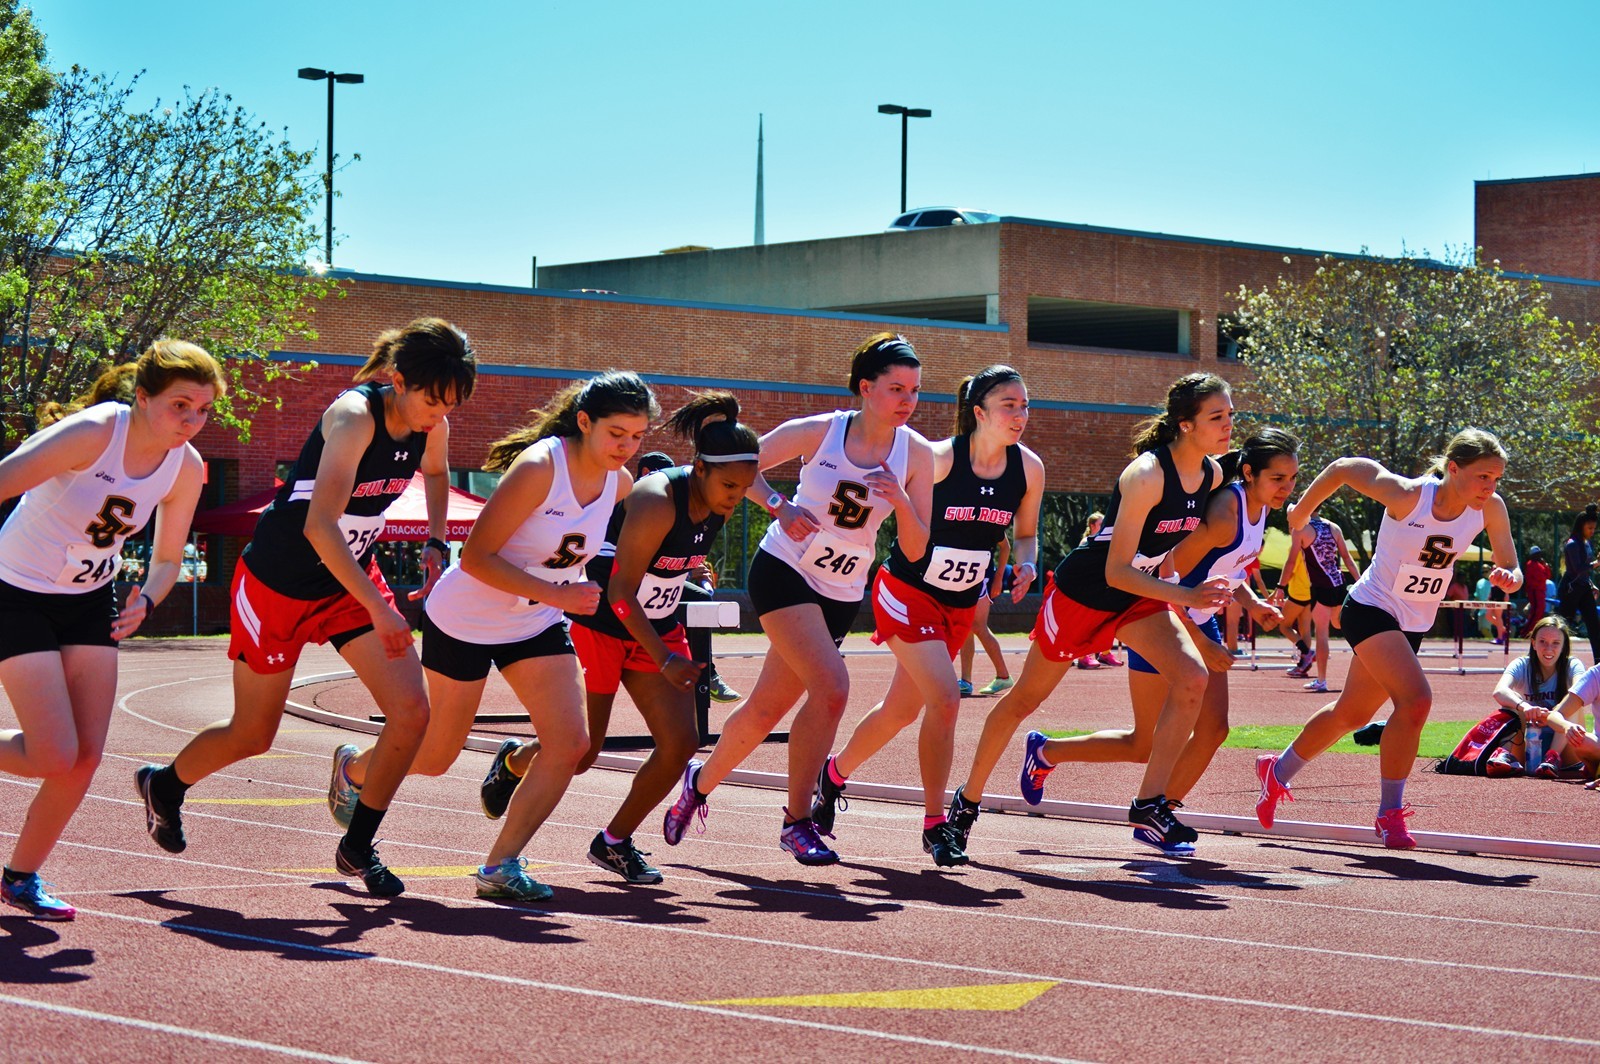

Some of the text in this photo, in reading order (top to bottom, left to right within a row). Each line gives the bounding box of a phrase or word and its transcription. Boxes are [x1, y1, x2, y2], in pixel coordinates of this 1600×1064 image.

[352, 480, 386, 497] SUL
[944, 506, 1013, 526] SUL ROSS
[1154, 518, 1184, 533] SUL
[654, 555, 687, 570] SUL
[814, 546, 860, 575] 246
[938, 559, 981, 583] 255
[1404, 575, 1443, 594] 250
[643, 585, 681, 609] 259
